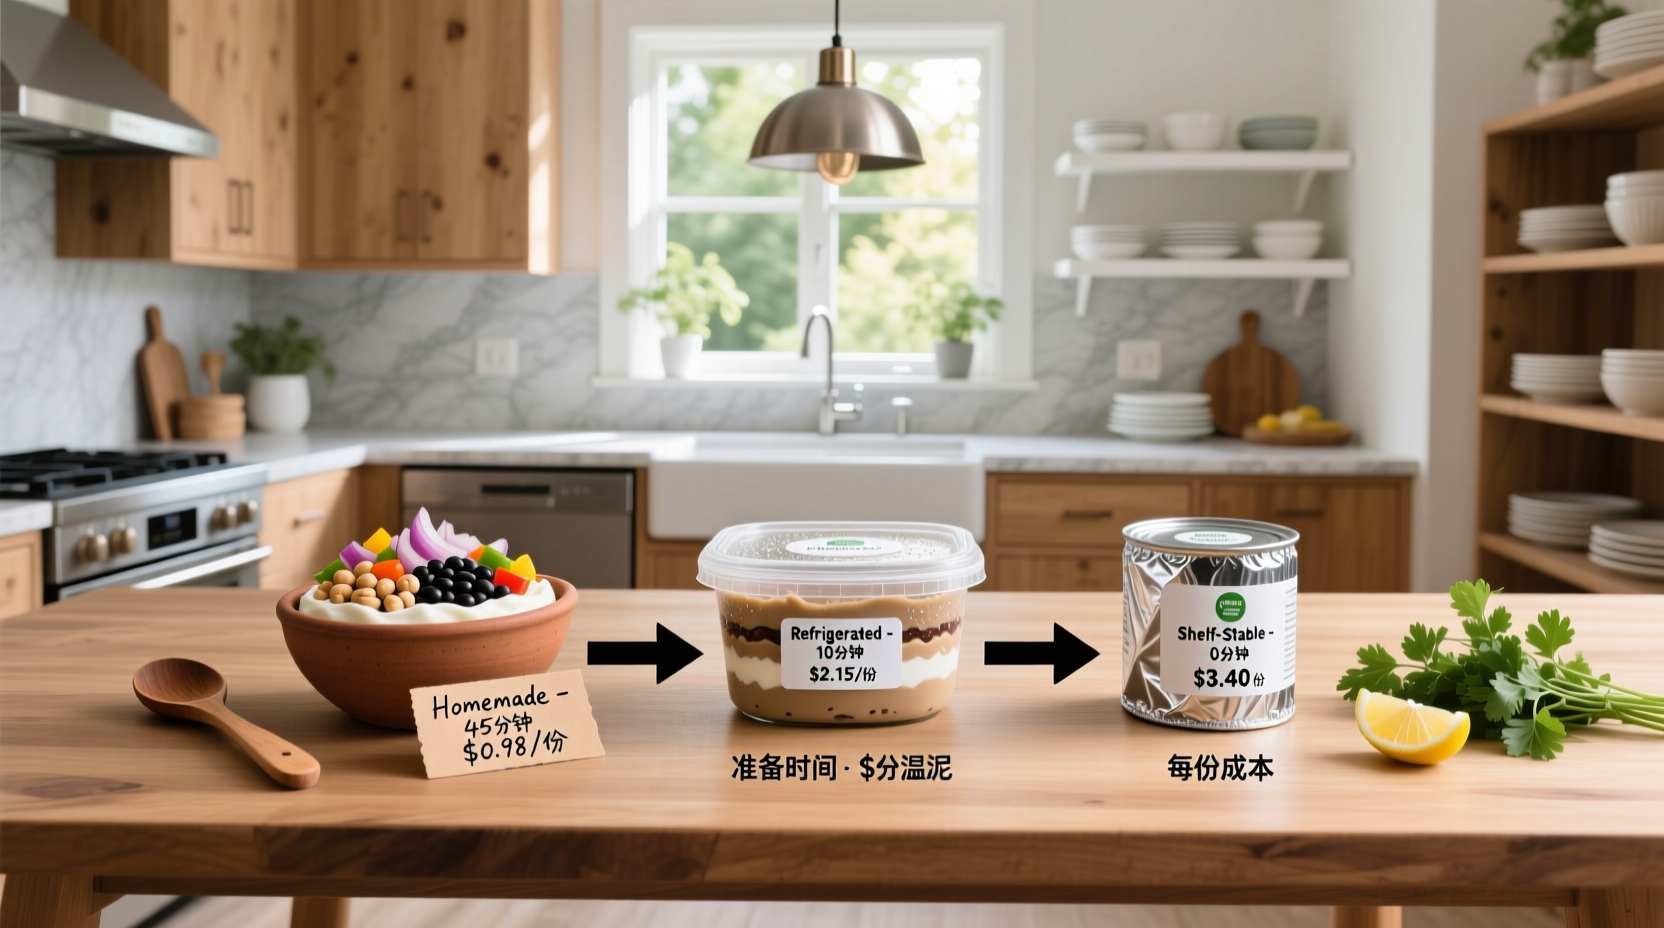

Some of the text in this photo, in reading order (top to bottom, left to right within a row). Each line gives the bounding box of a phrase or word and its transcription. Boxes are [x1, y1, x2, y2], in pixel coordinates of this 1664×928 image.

[791, 625, 882, 645] Refrigerated
[1177, 626, 1266, 642] Shelf-Stable
[815, 644, 864, 660] 10分钟
[809, 665, 878, 685] $2.15/份
[1194, 666, 1251, 689] $3.40
[432, 684, 549, 720] Homemade
[464, 711, 533, 738] 45分钟
[463, 729, 568, 766] $0.98/份
